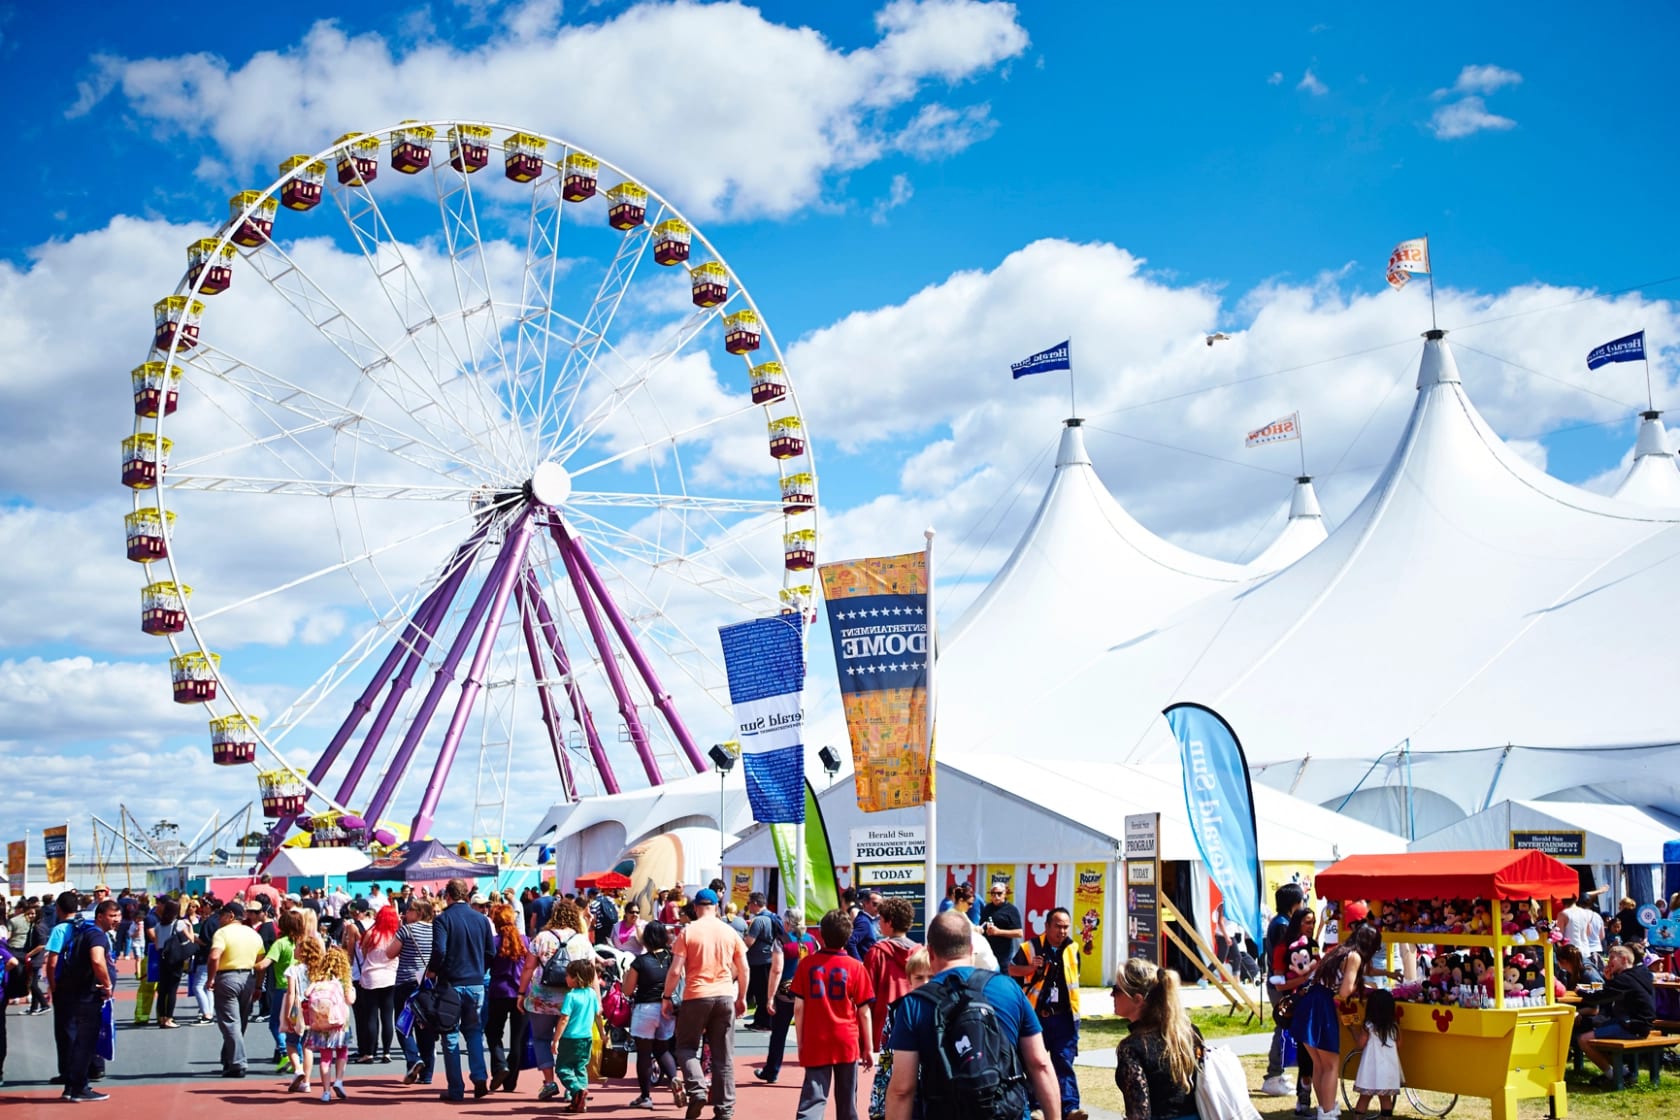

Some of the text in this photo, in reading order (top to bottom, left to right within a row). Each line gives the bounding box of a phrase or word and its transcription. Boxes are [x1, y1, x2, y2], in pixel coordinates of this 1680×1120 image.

[868, 829, 914, 839] Herald Sun
[1127, 839, 1155, 852] PROGRAM
[856, 846, 926, 858] PROGRAM
[871, 869, 913, 880] TODAY
[1132, 868, 1149, 879] TODAY
[809, 965, 848, 1001] 68
